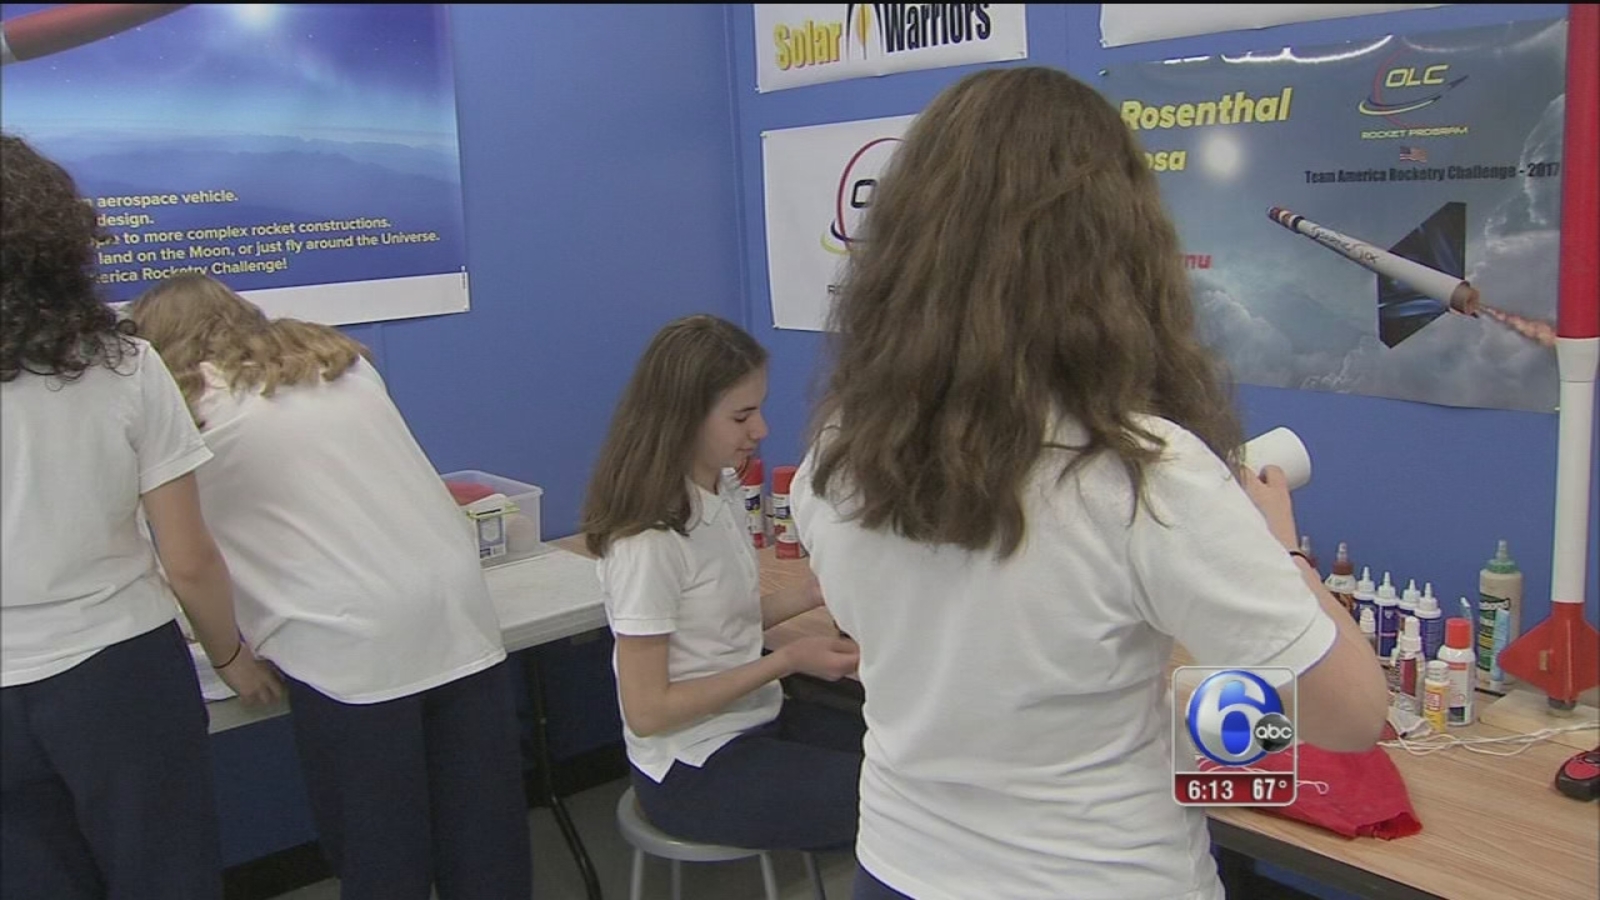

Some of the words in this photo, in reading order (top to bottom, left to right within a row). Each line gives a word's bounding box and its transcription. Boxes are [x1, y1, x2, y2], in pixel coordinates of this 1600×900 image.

[774, 20, 842, 70] Solar
[885, 4, 991, 53] Warriors
[1385, 64, 1449, 87] OLC
[1120, 87, 1293, 130] Rosenthal
[1361, 128, 1407, 139] ROCKET
[1408, 126, 1468, 137] PROGRAM
[1304, 170, 1336, 183] Team
[1338, 168, 1387, 182] America
[1389, 166, 1445, 182] Rocketry
[1447, 164, 1516, 180] Challenge
[1527, 162, 1560, 178] 2017
[97, 193, 178, 208] aerospace
[182, 189, 239, 204] vehicle.
[97, 212, 154, 228] design.
[124, 232, 140, 244] to
[144, 230, 183, 243] more
[187, 226, 248, 242] complex
[251, 222, 296, 236] rocket
[299, 217, 391, 233] constructions.
[98, 251, 132, 265] land
[136, 250, 157, 262] on
[160, 247, 185, 260] the
[189, 246, 235, 259] Moon,
[238, 244, 253, 255] or
[254, 241, 283, 256] just
[285, 239, 303, 254] fly
[306, 235, 354, 250] around
[356, 234, 379, 247] the
[381, 231, 441, 245] Universe.
[96, 270, 138, 284] erica
[211, 257, 288, 275] Challenge!
